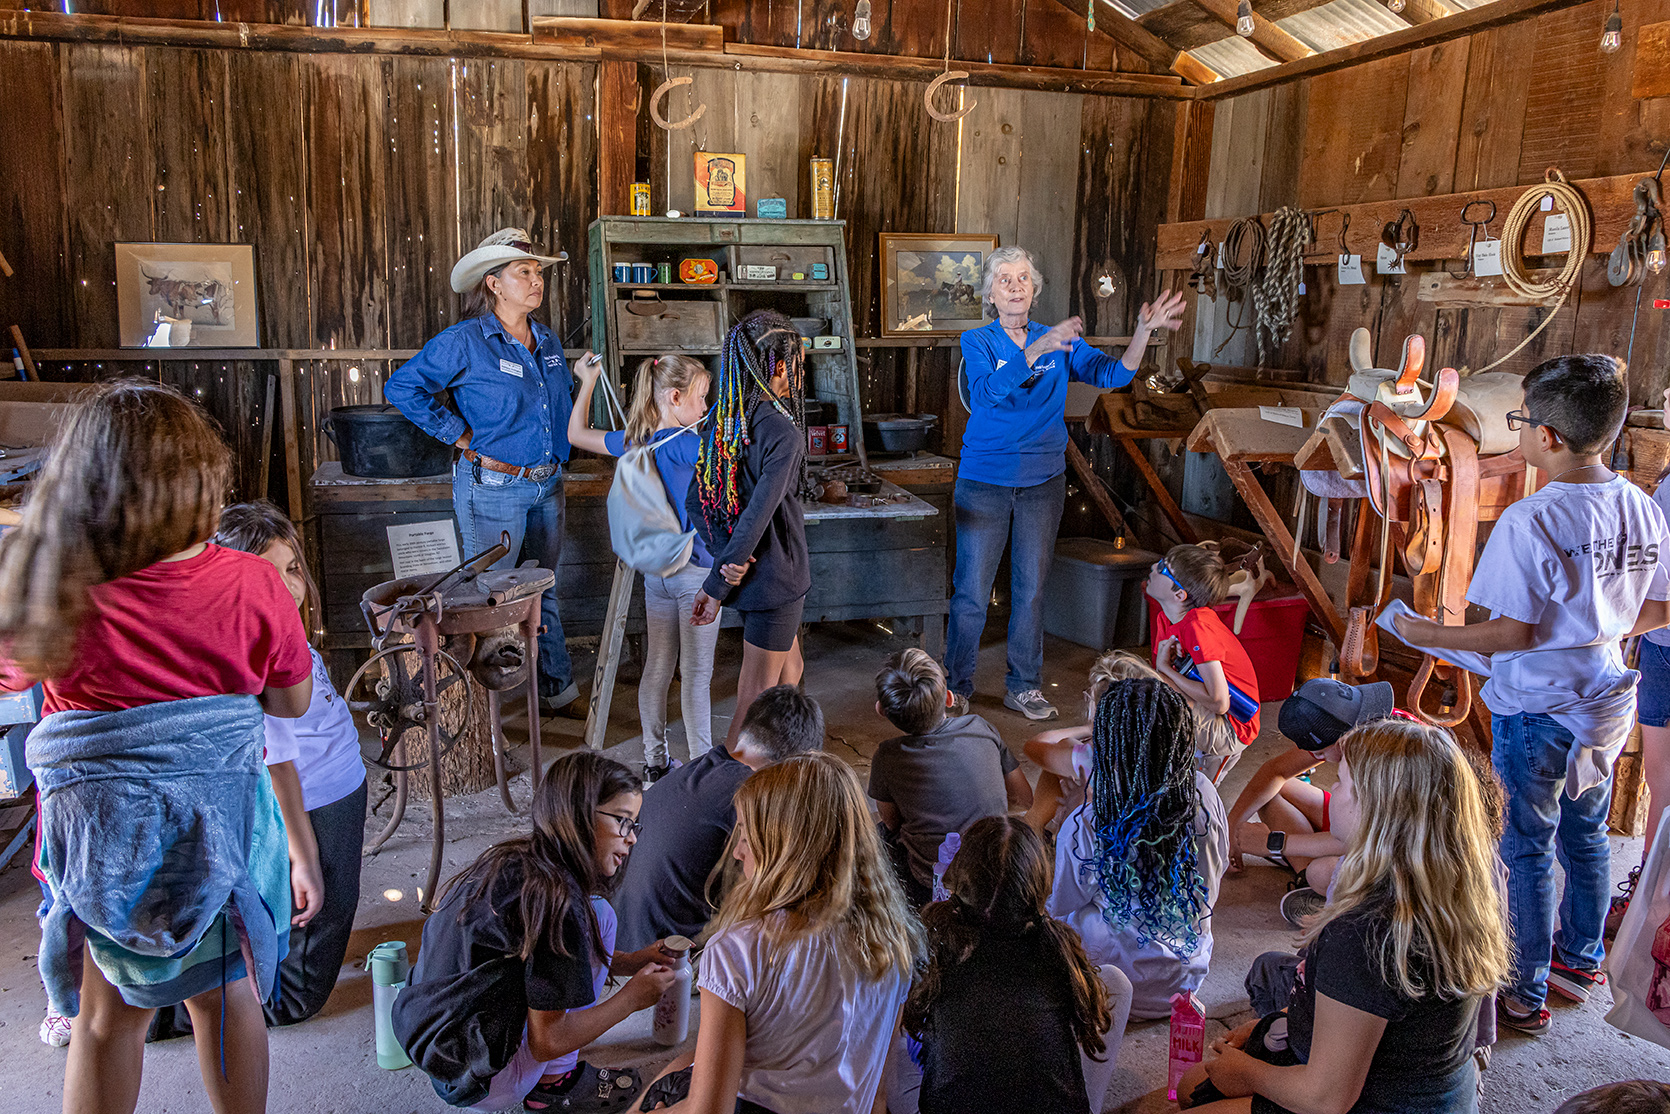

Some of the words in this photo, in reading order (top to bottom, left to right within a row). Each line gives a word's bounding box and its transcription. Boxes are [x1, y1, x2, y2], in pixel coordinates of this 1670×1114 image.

[1564, 543, 1592, 558] WE
[1593, 537, 1614, 551] THE
[1173, 1037, 1200, 1053] MILK
